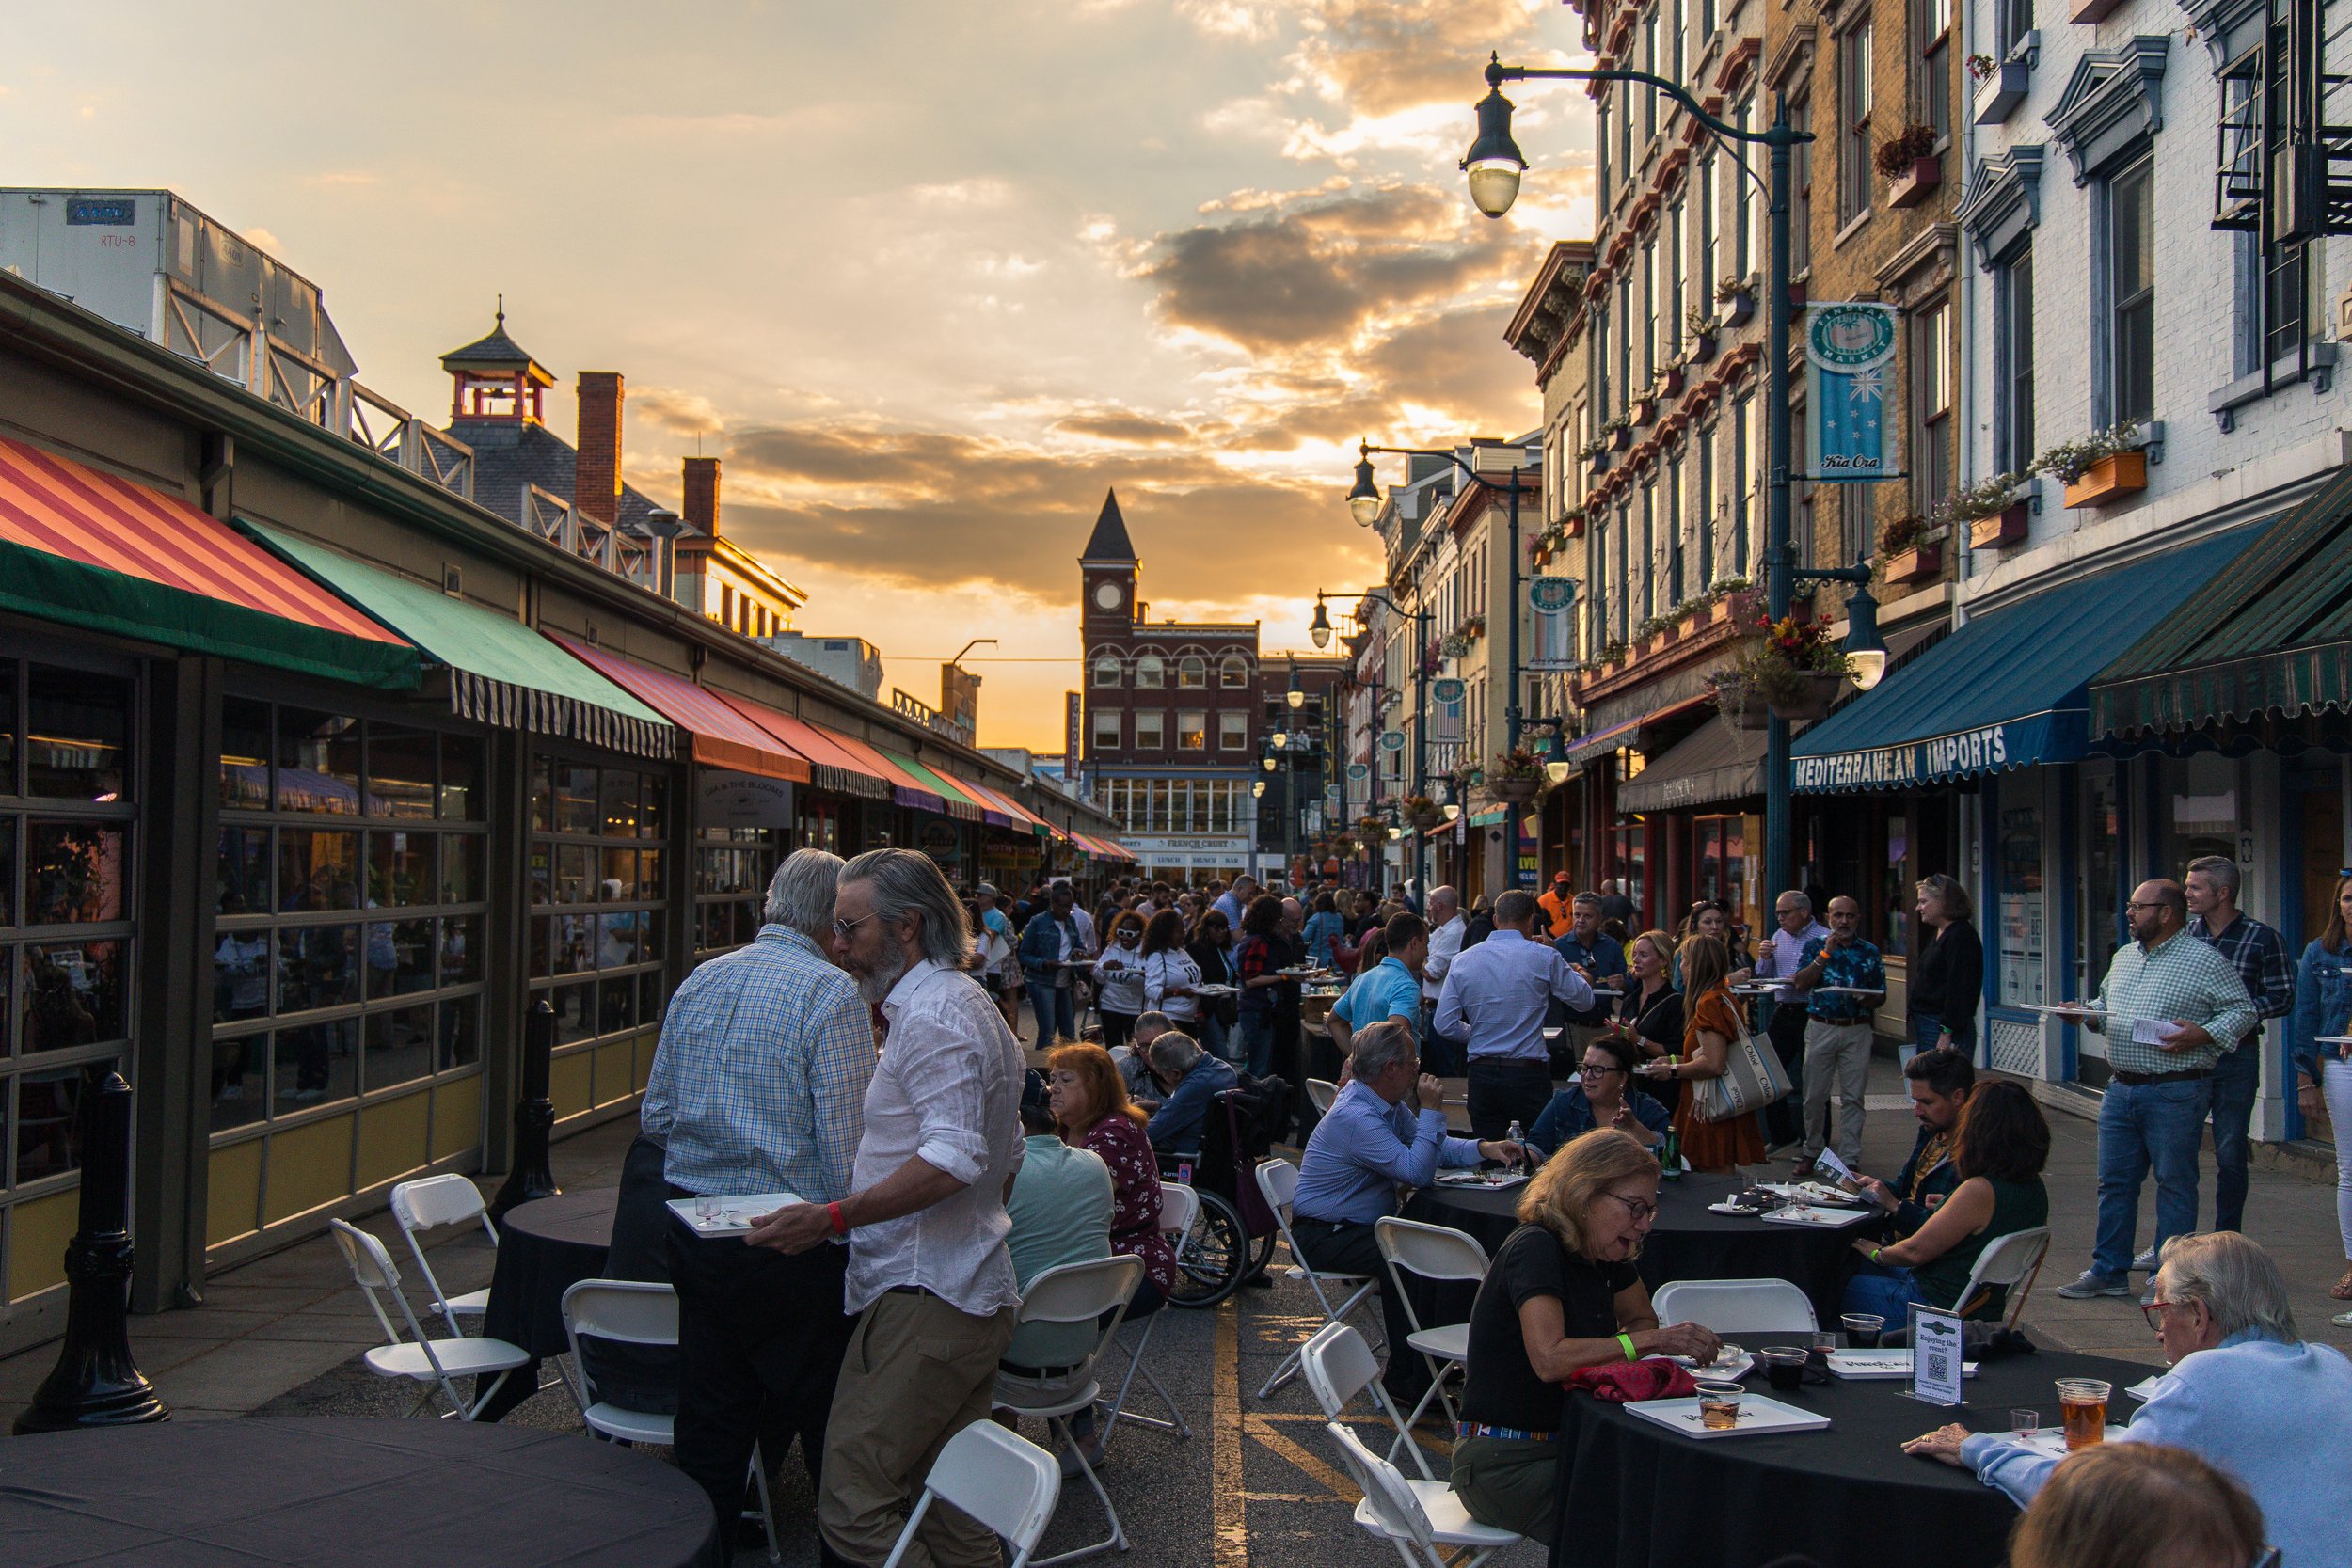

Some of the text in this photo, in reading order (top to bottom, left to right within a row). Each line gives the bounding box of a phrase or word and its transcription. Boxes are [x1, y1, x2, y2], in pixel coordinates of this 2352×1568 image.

[101, 234, 135, 247] RTU-8
[1818, 305, 1885, 326] FINDLAY
[1823, 341, 1886, 363] MARKET
[1820, 453, 1879, 468] Kia Ora
[1795, 725, 2007, 787] MEDITERRANEAN IMPORTS
[730, 781, 746, 789] THE
[748, 781, 784, 798] BLOOMS
[986, 843, 1012, 853] ROTH
[1167, 839, 1229, 847] FRENCH CRUST
[1744, 1045, 1759, 1067] Chloé
[1919, 1334, 1957, 1348] Enjoying the
[1928, 1345, 1947, 1354] event?
